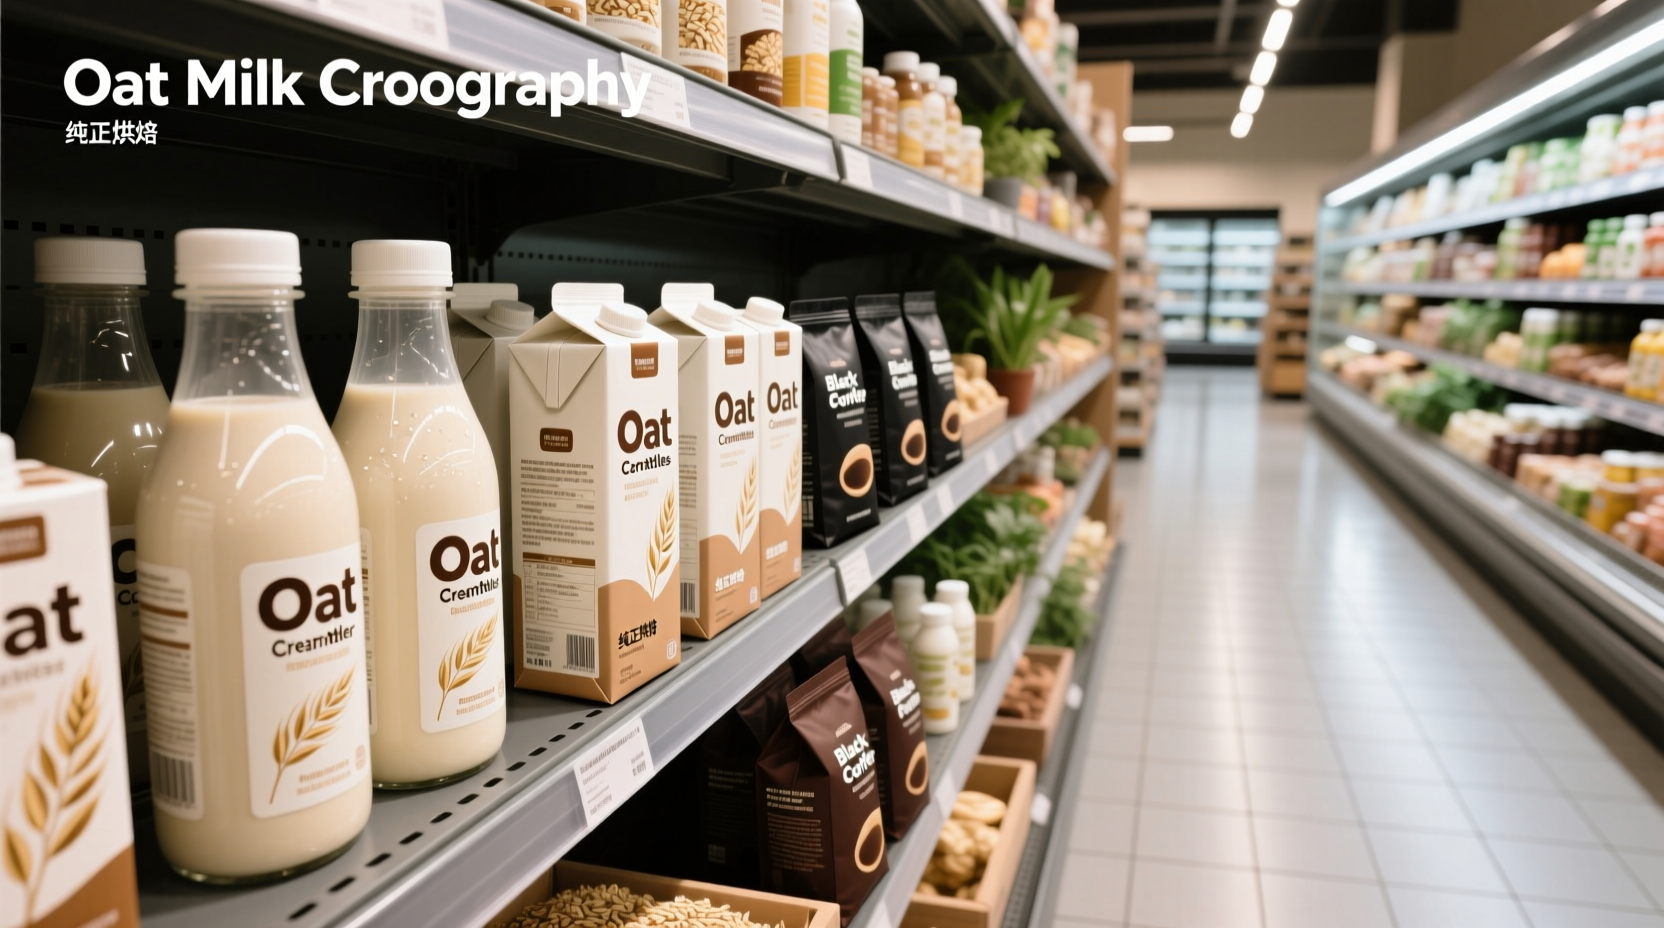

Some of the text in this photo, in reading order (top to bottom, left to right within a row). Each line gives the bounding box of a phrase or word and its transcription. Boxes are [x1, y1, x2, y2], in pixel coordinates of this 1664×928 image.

[714, 390, 755, 428] Oat
[767, 381, 798, 414] Oat
[617, 408, 672, 454] Oat
[429, 528, 499, 582] Oat
[258, 567, 357, 632] Oat
[834, 733, 869, 767] Black
